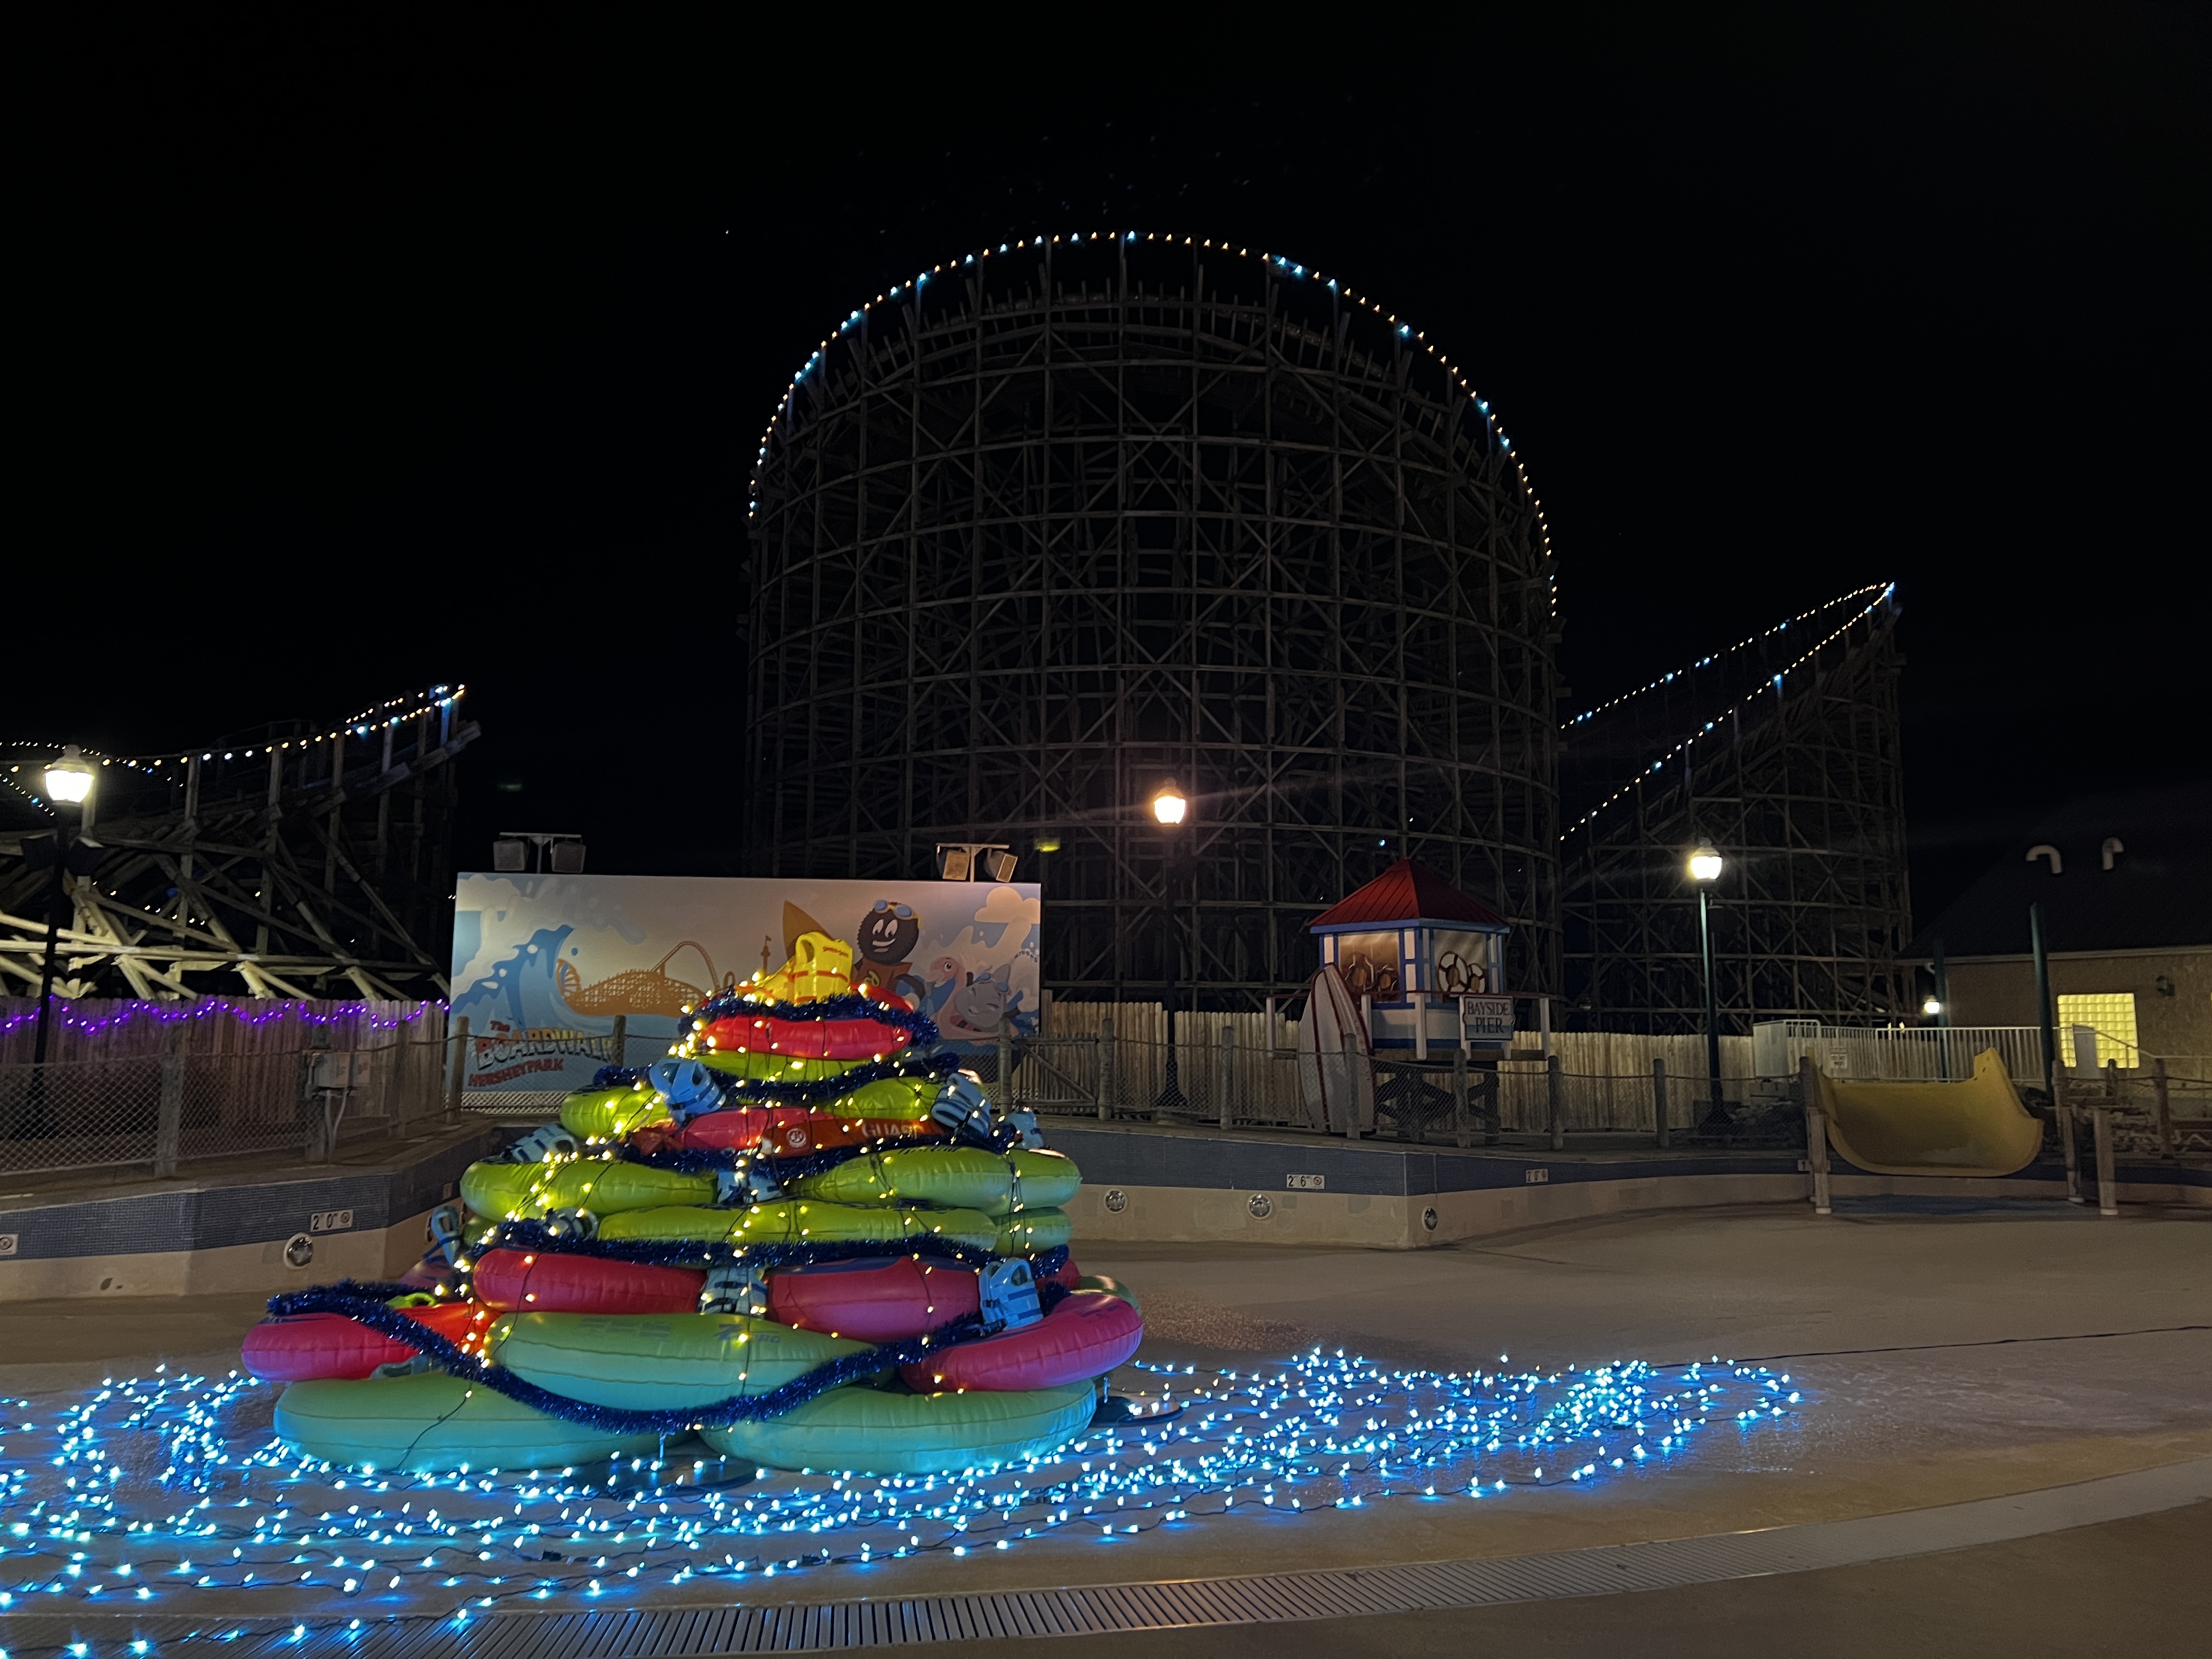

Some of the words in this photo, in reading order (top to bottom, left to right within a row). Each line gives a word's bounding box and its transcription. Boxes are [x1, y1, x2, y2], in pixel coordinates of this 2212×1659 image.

[1468, 1001, 1510, 1015] BAYSIDE
[1475, 1017, 1504, 1033] PIER
[468, 1059, 564, 1087] HERSHEYPARK
